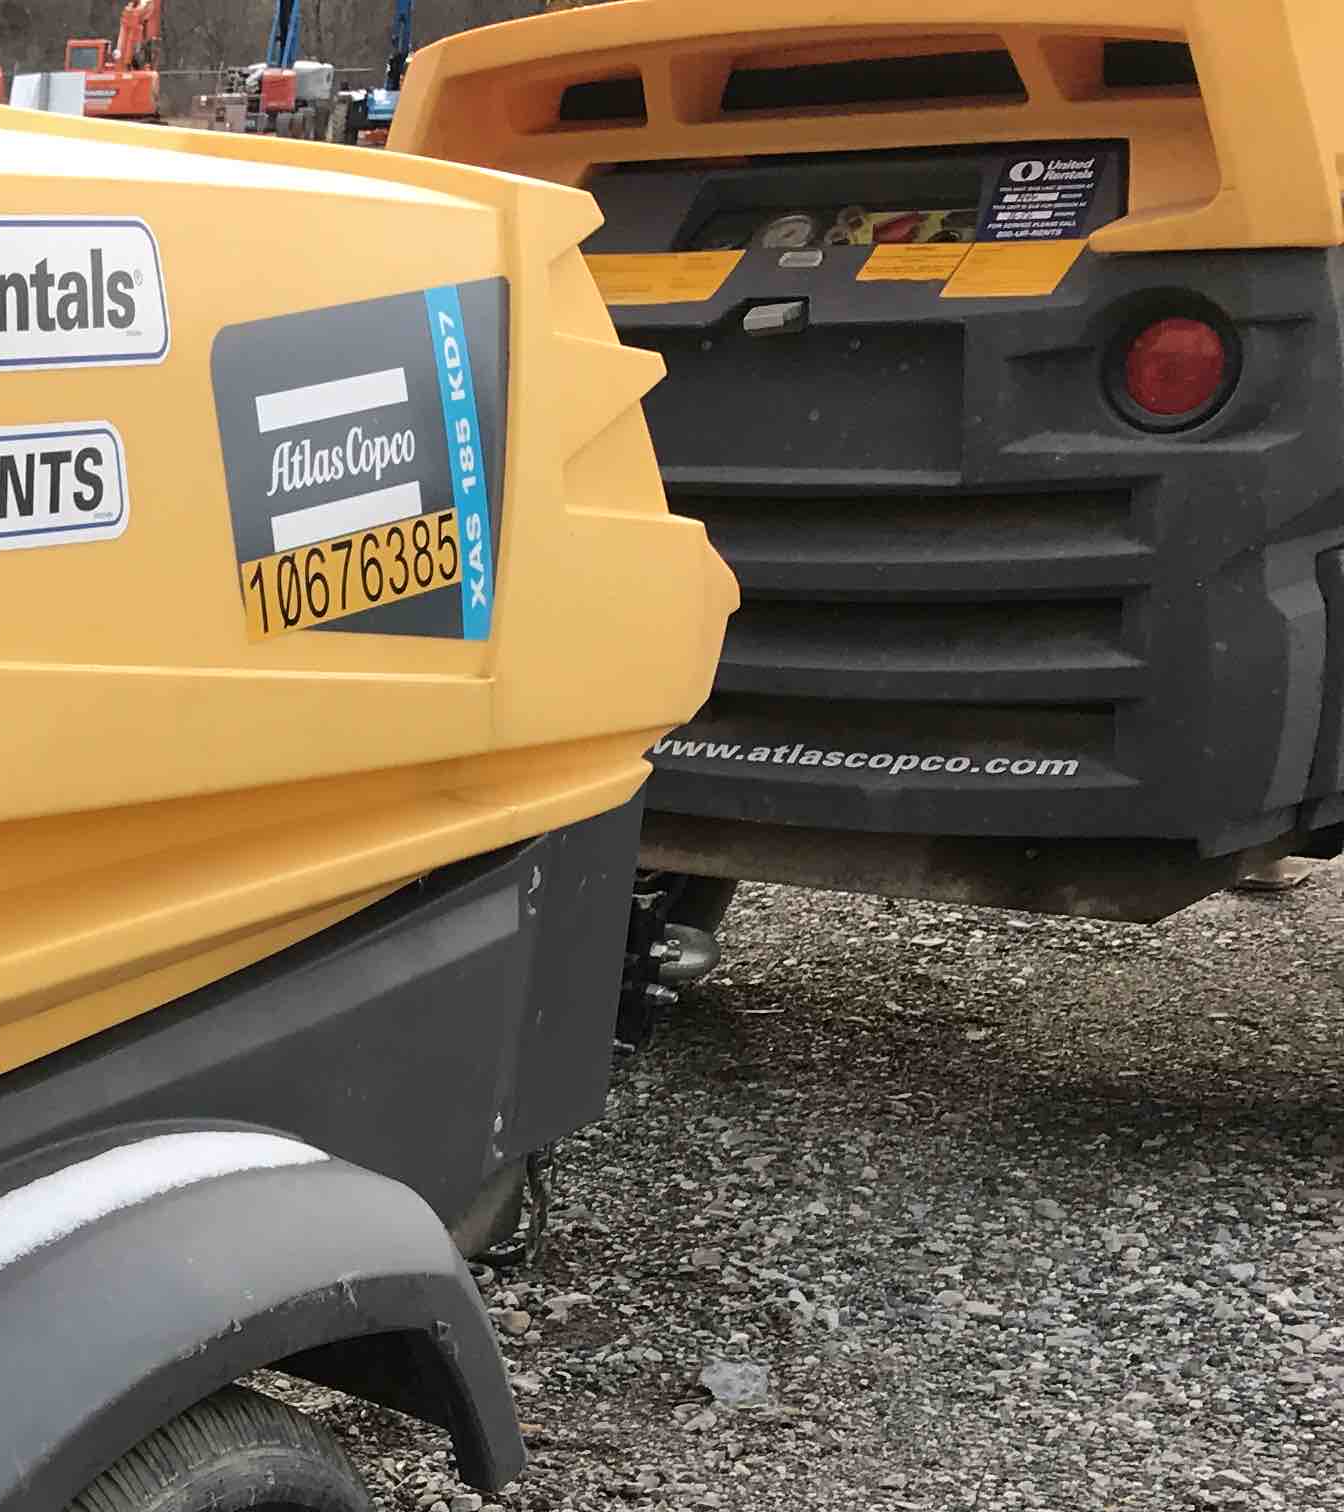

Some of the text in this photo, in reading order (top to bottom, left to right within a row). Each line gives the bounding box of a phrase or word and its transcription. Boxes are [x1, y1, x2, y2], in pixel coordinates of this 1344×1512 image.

[1043, 169, 1093, 181] Rentals
[1047, 157, 1095, 170] United
[438, 310, 488, 609] XAS 185 KD7
[249, 512, 459, 635] 10676385
